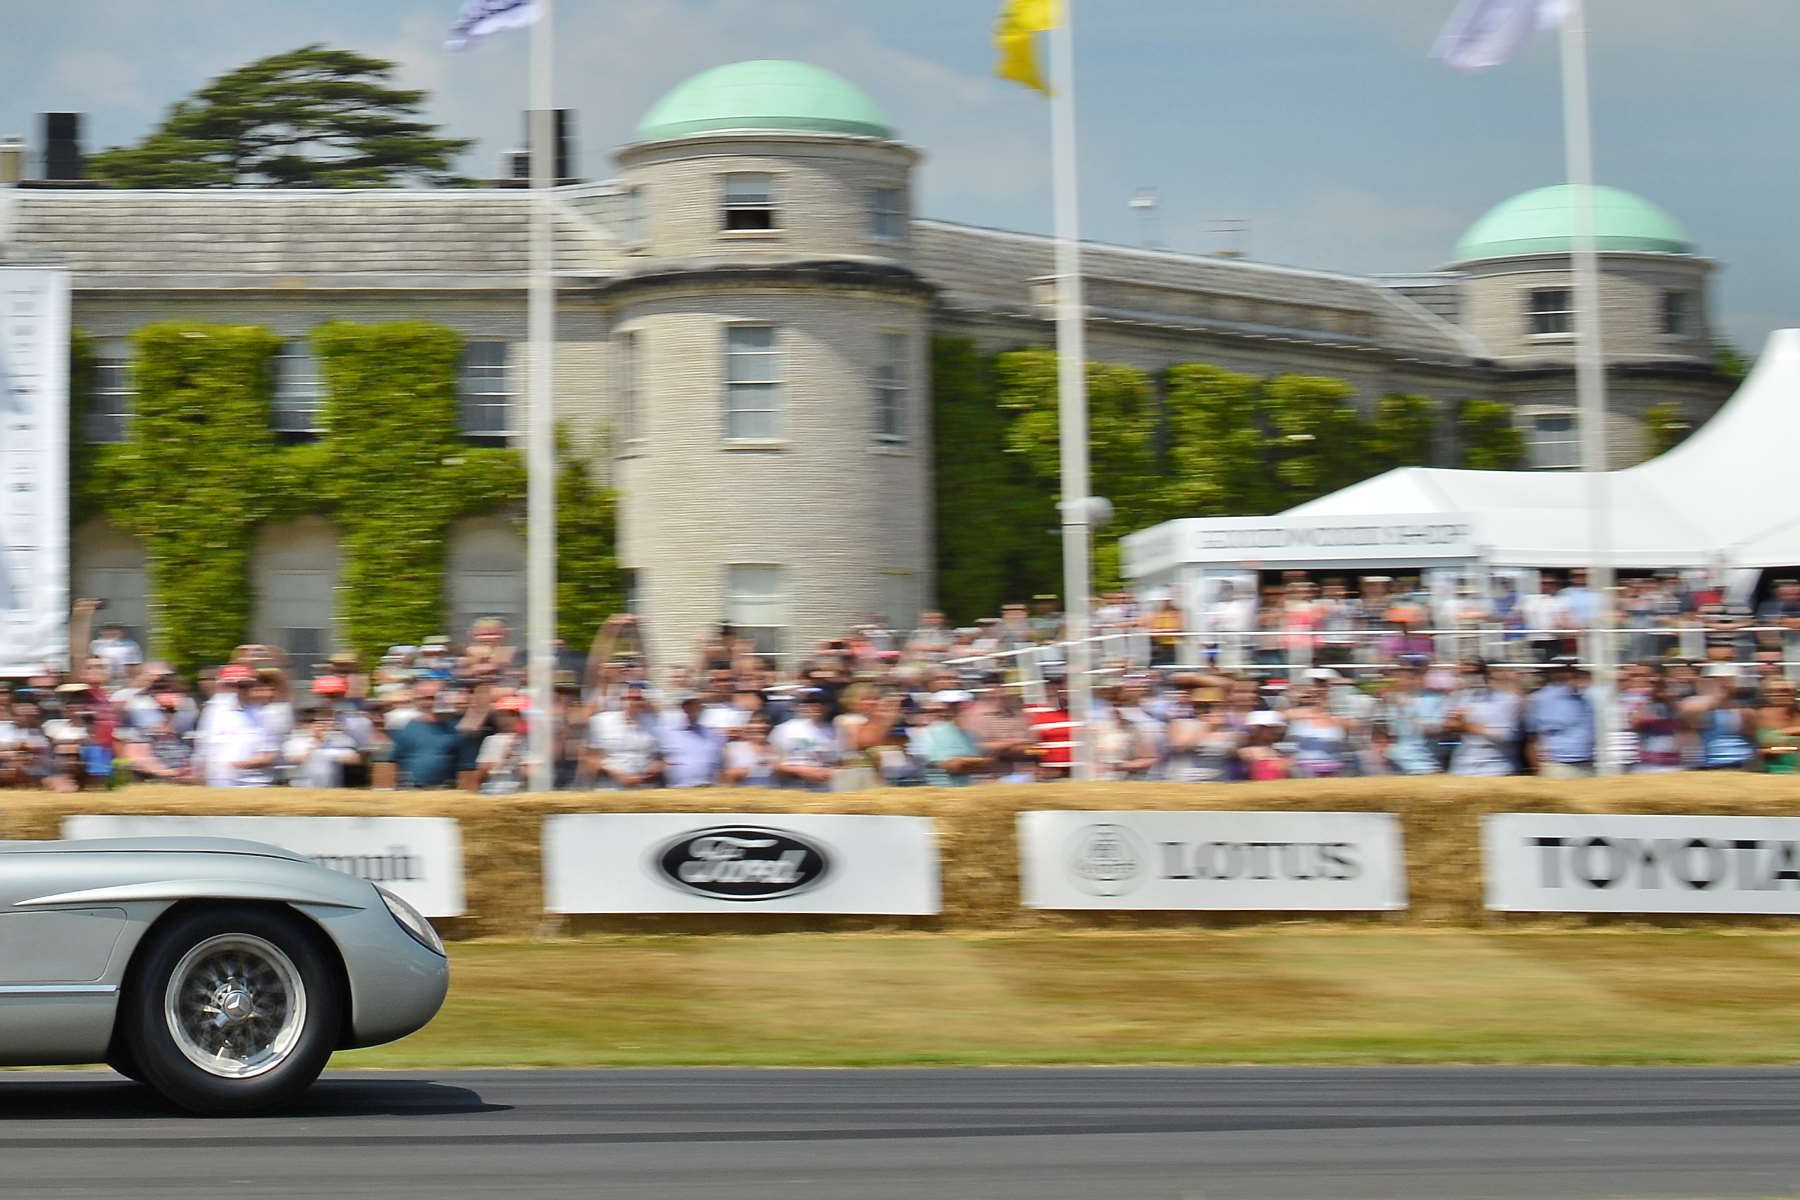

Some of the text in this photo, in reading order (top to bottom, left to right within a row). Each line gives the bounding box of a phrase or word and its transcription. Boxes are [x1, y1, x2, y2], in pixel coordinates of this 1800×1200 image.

[678, 836, 808, 883] Ford
[1157, 841, 1364, 880] LOTUS
[1527, 836, 1800, 890] TOYOTA
